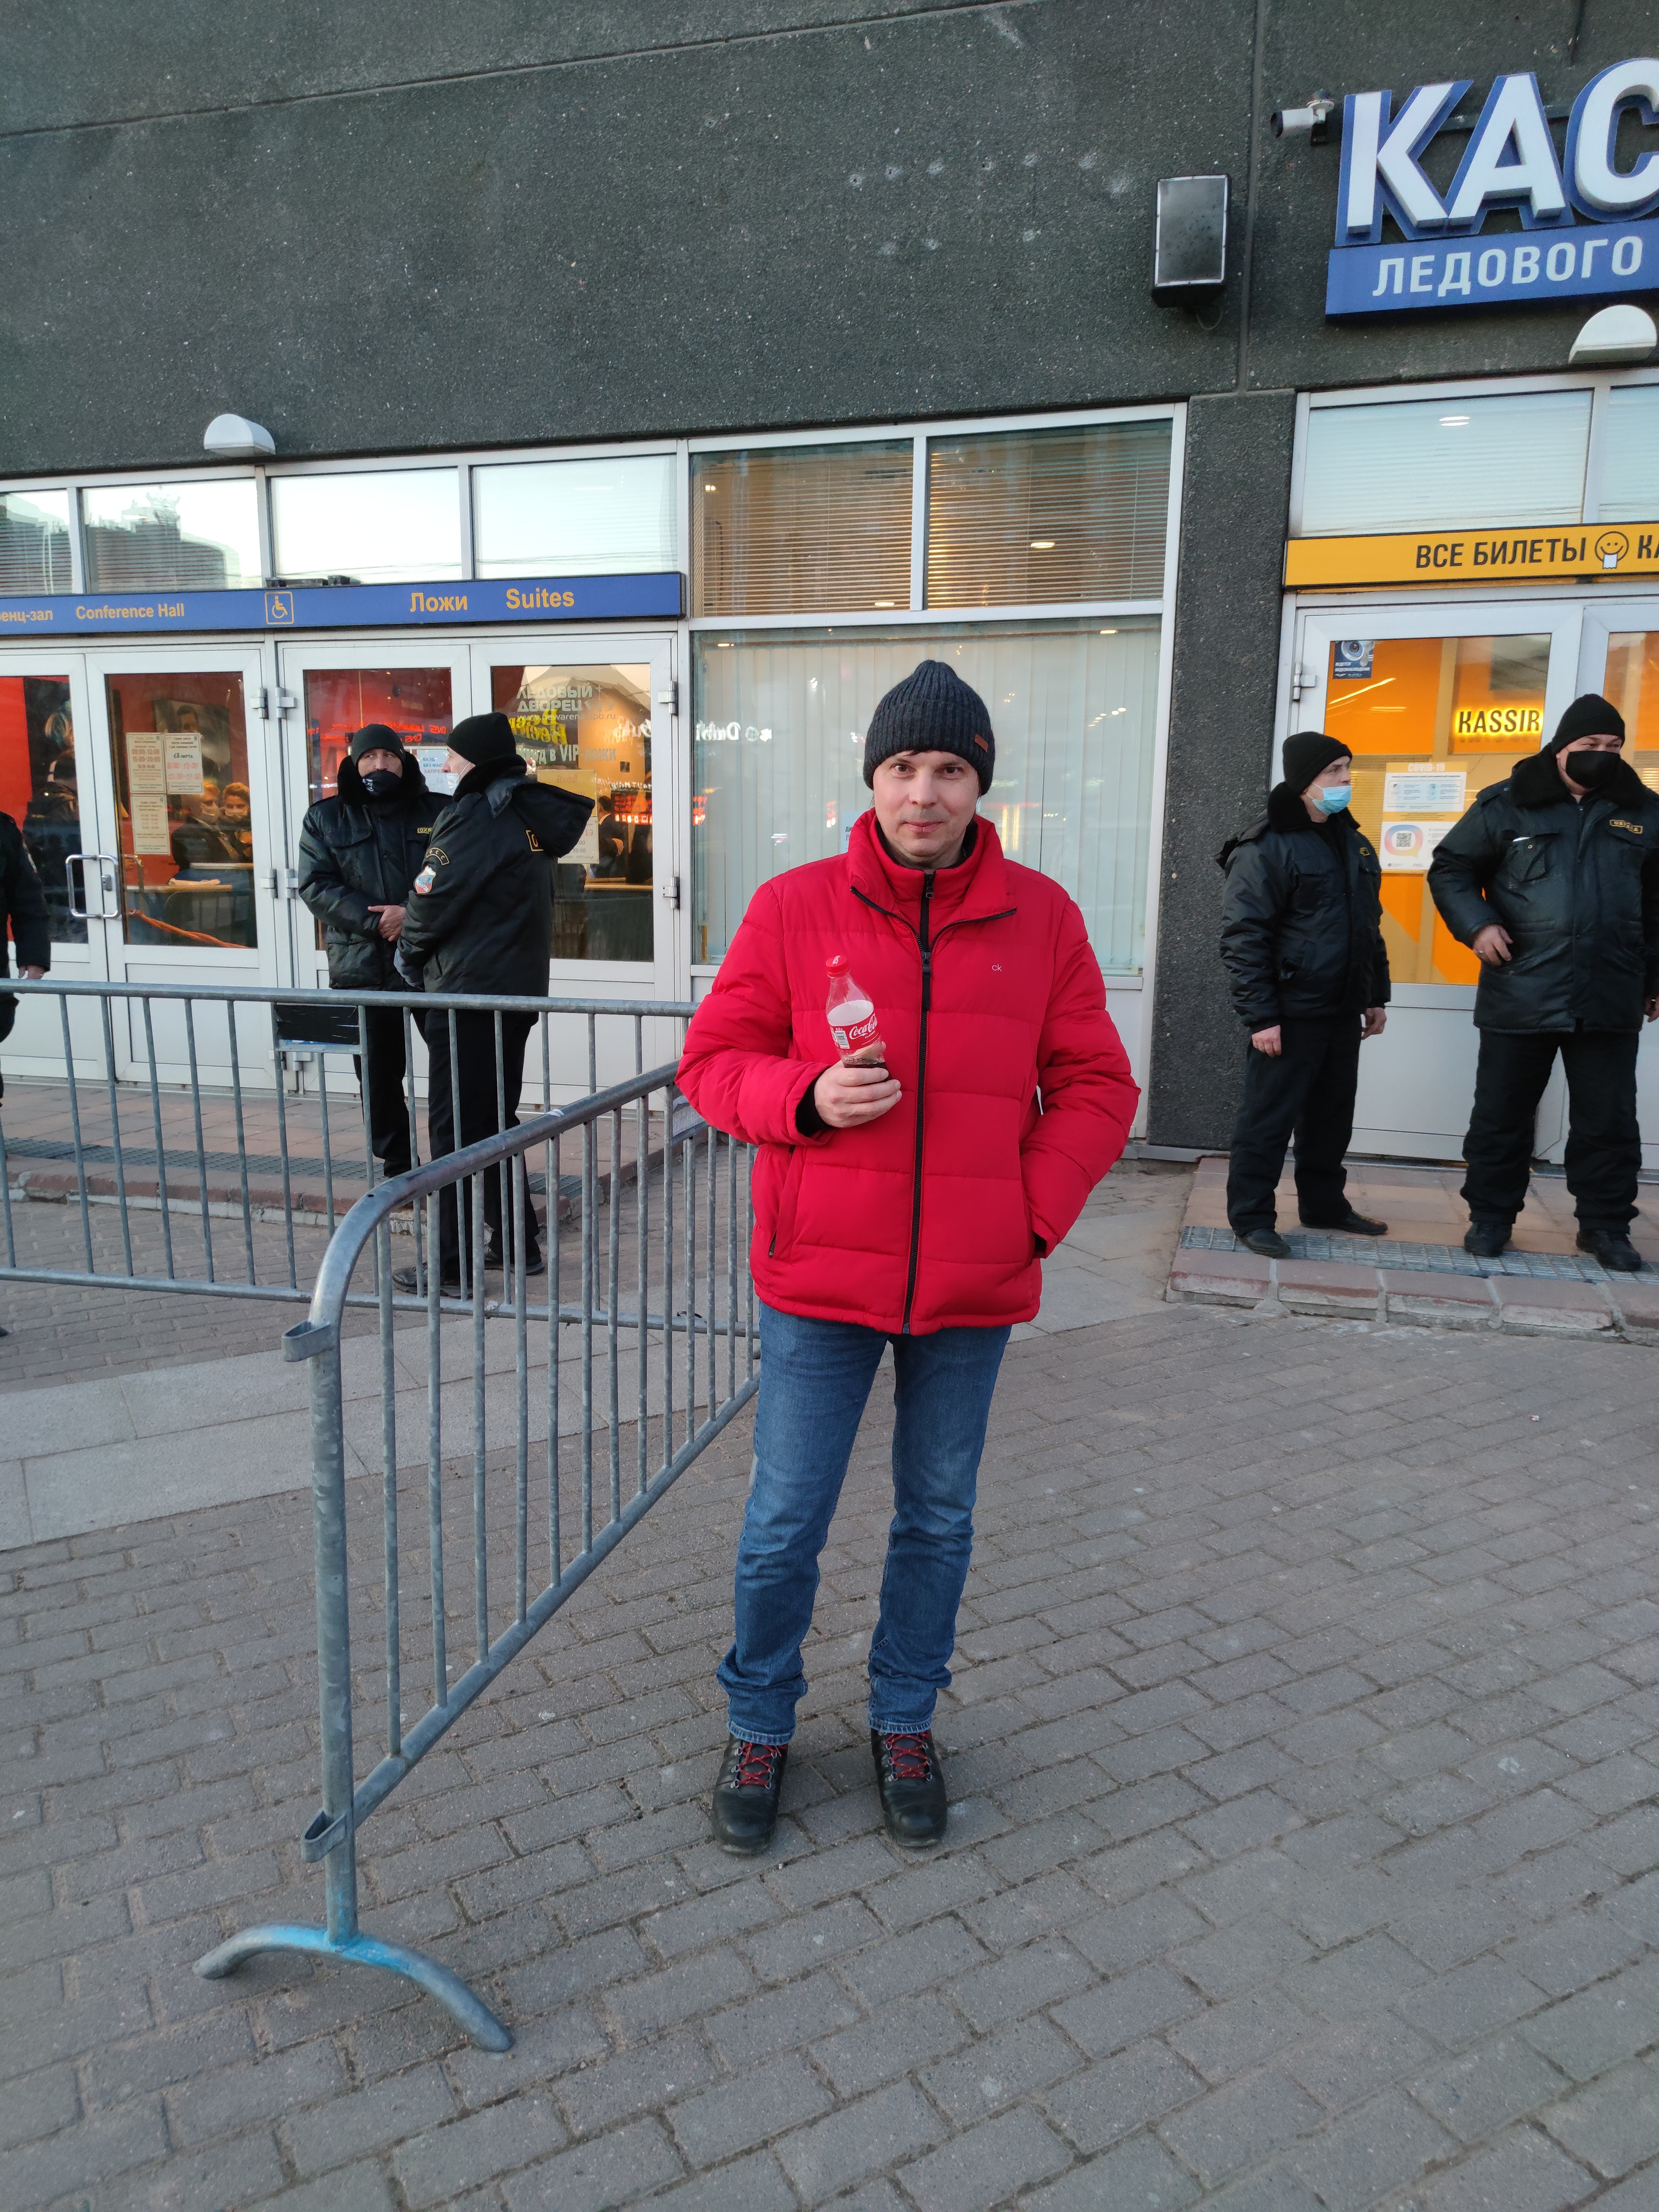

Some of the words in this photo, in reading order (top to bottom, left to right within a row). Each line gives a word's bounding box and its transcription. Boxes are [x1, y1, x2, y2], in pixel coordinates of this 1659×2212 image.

[1373, 236, 1643, 297] ЛЕДОВОГО
[1416, 543, 1464, 568] ВСЕ
[1473, 537, 1587, 566] БИЛЕТЫ
[410, 592, 468, 612] Ложи
[506, 588, 575, 609] Suites
[0, 609, 53, 624] енц-зал
[76, 605, 154, 620] Conference
[158, 603, 184, 617] Hall
[517, 699, 583, 712] ДВОРЕЦ
[1458, 710, 1540, 733] KASSIR
